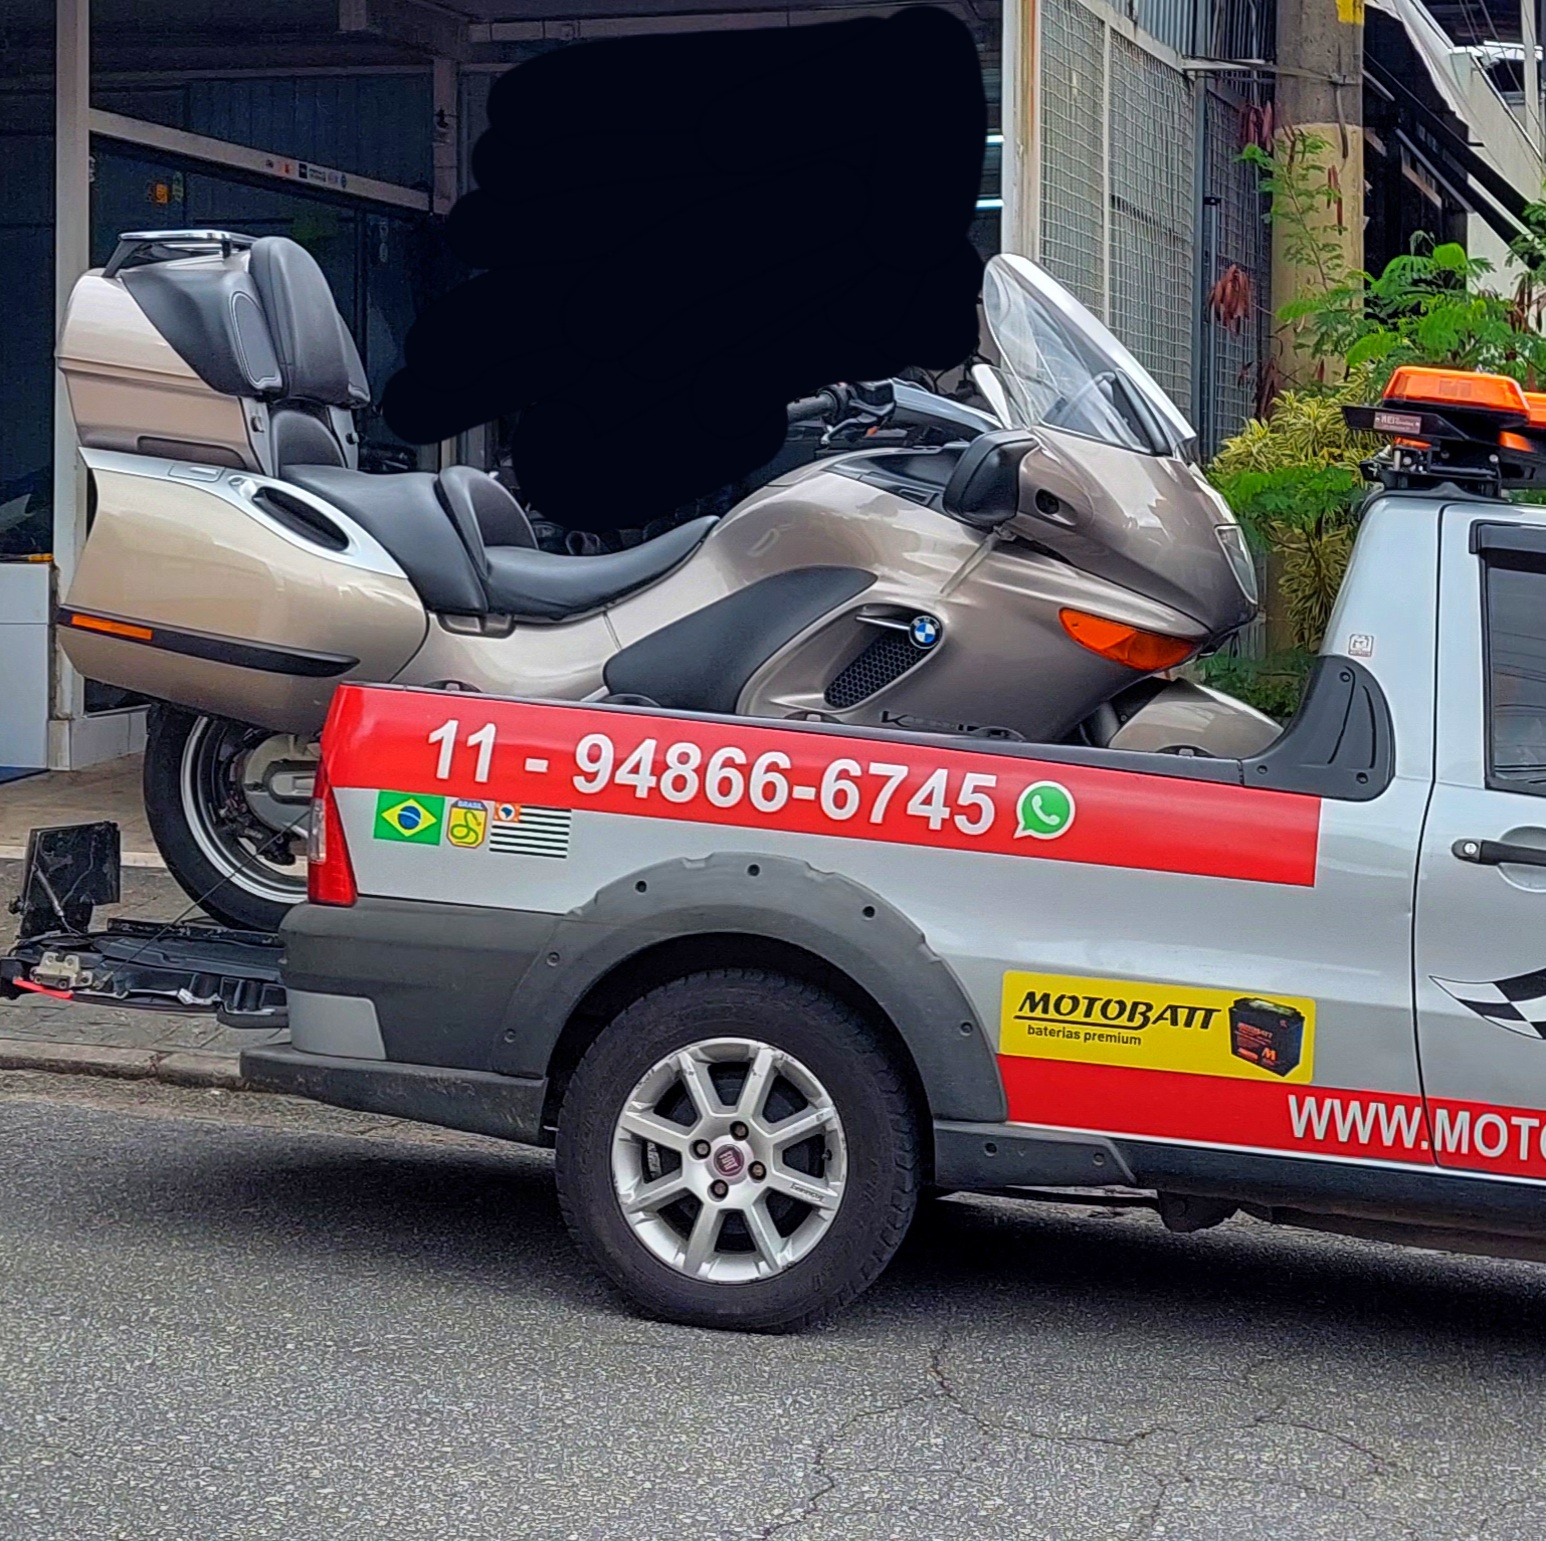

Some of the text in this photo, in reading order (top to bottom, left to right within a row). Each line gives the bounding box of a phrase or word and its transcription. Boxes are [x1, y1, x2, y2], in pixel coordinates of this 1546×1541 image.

[426, 719, 498, 784] 11
[570, 732, 998, 836] 94866-6745
[1014, 991, 1222, 1031] MOTOBATT
[1027, 1024, 1142, 1046] baterias premium
